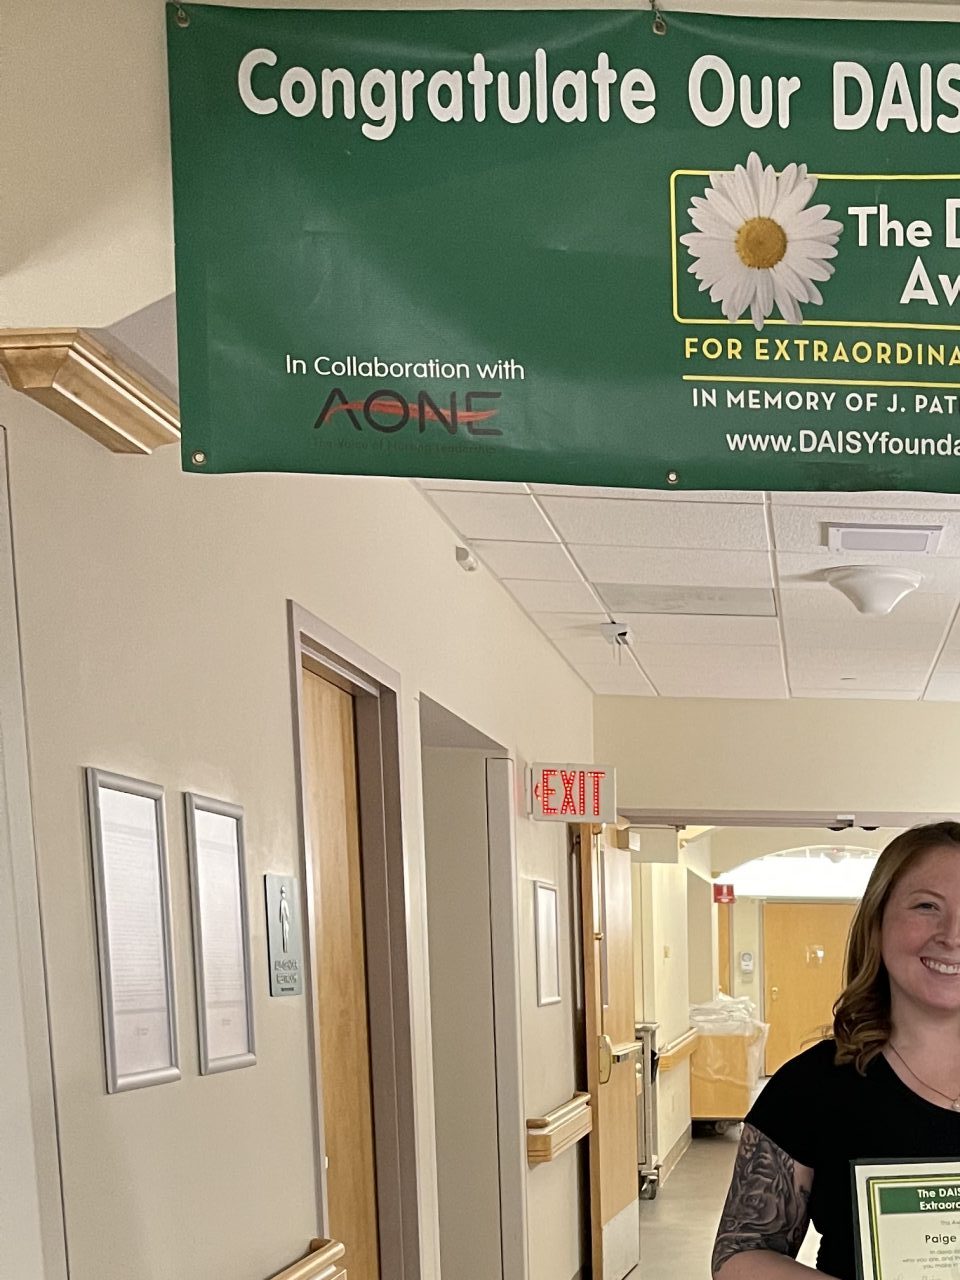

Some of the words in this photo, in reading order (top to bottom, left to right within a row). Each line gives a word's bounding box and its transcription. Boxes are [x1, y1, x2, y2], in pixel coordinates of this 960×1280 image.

[238, 48, 656, 141] Congratulate
[688, 55, 801, 128] Our
[848, 203, 932, 248] The
[684, 338, 743, 360] FOR
[286, 355, 307, 375] In
[314, 356, 470, 379] Collaboration
[476, 359, 526, 380] with
[313, 387, 504, 436] AONE
[692, 388, 717, 408] IN
[726, 389, 836, 411] MEMORY
[845, 393, 879, 412] OF
[887, 393, 906, 413] J.
[542, 769, 606, 816] EXIT
[917, 1188, 936, 1198] The
[925, 1233, 957, 1245] Paige
